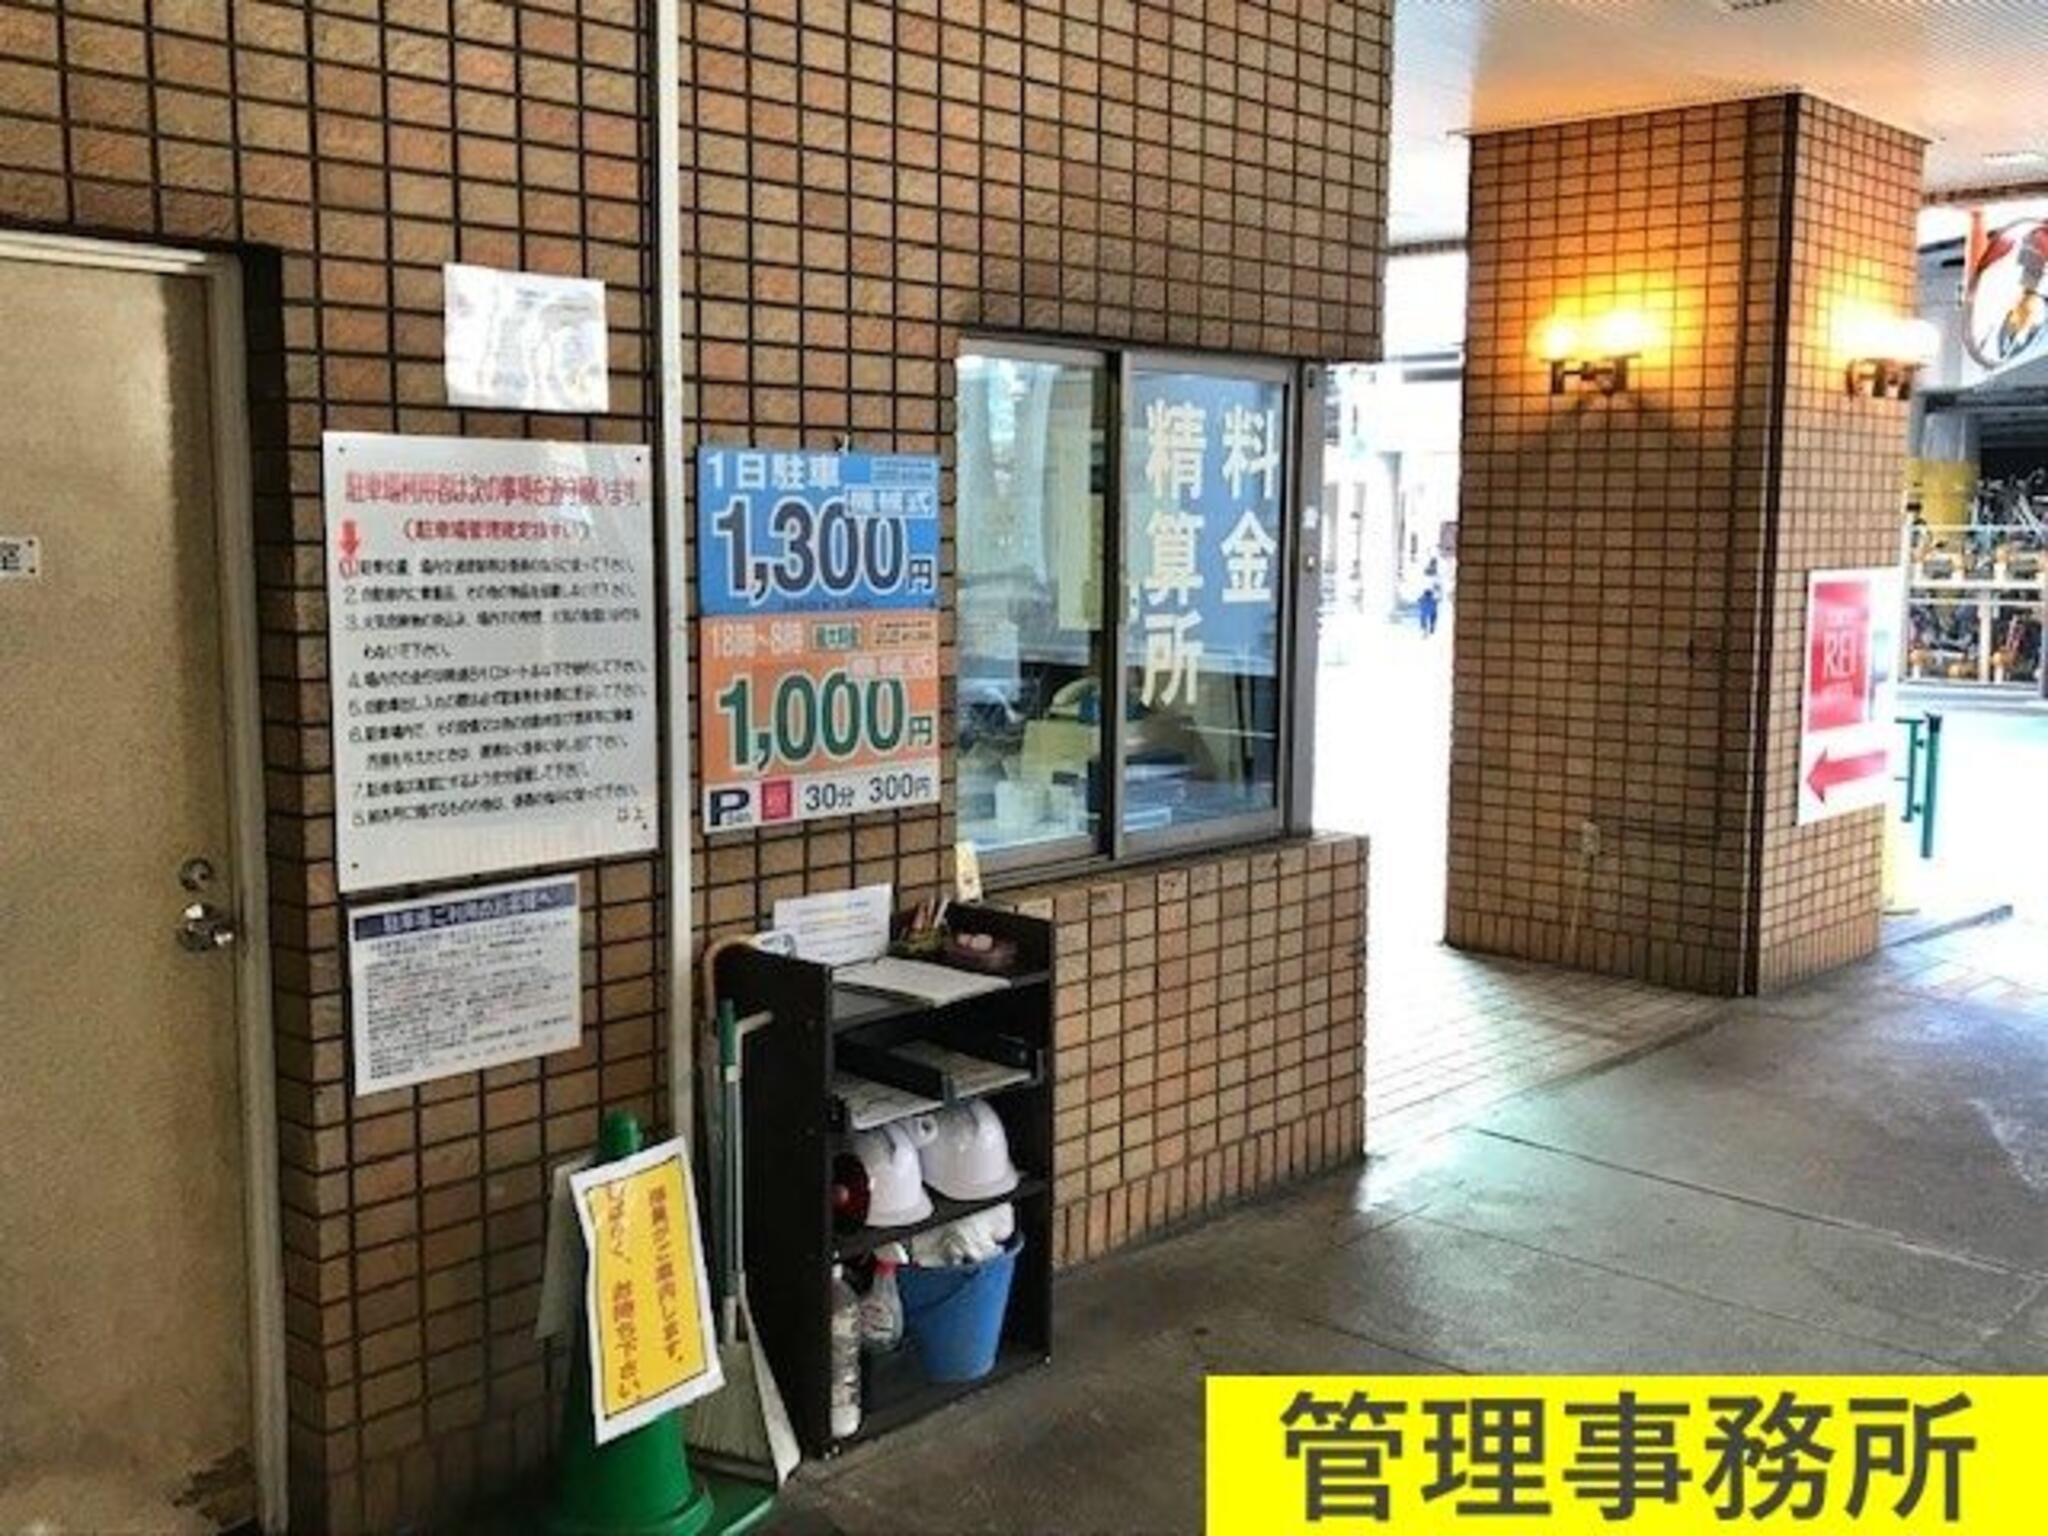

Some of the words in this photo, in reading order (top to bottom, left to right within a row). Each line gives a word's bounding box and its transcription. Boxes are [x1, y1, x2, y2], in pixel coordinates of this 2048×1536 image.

[706, 452, 841, 490] 1日駐車
[1222, 404, 1280, 603] 料金
[1140, 398, 1207, 707] 精算所
[709, 788, 750, 826] P
[805, 783, 855, 812] 30分
[869, 773, 931, 802] 300円
